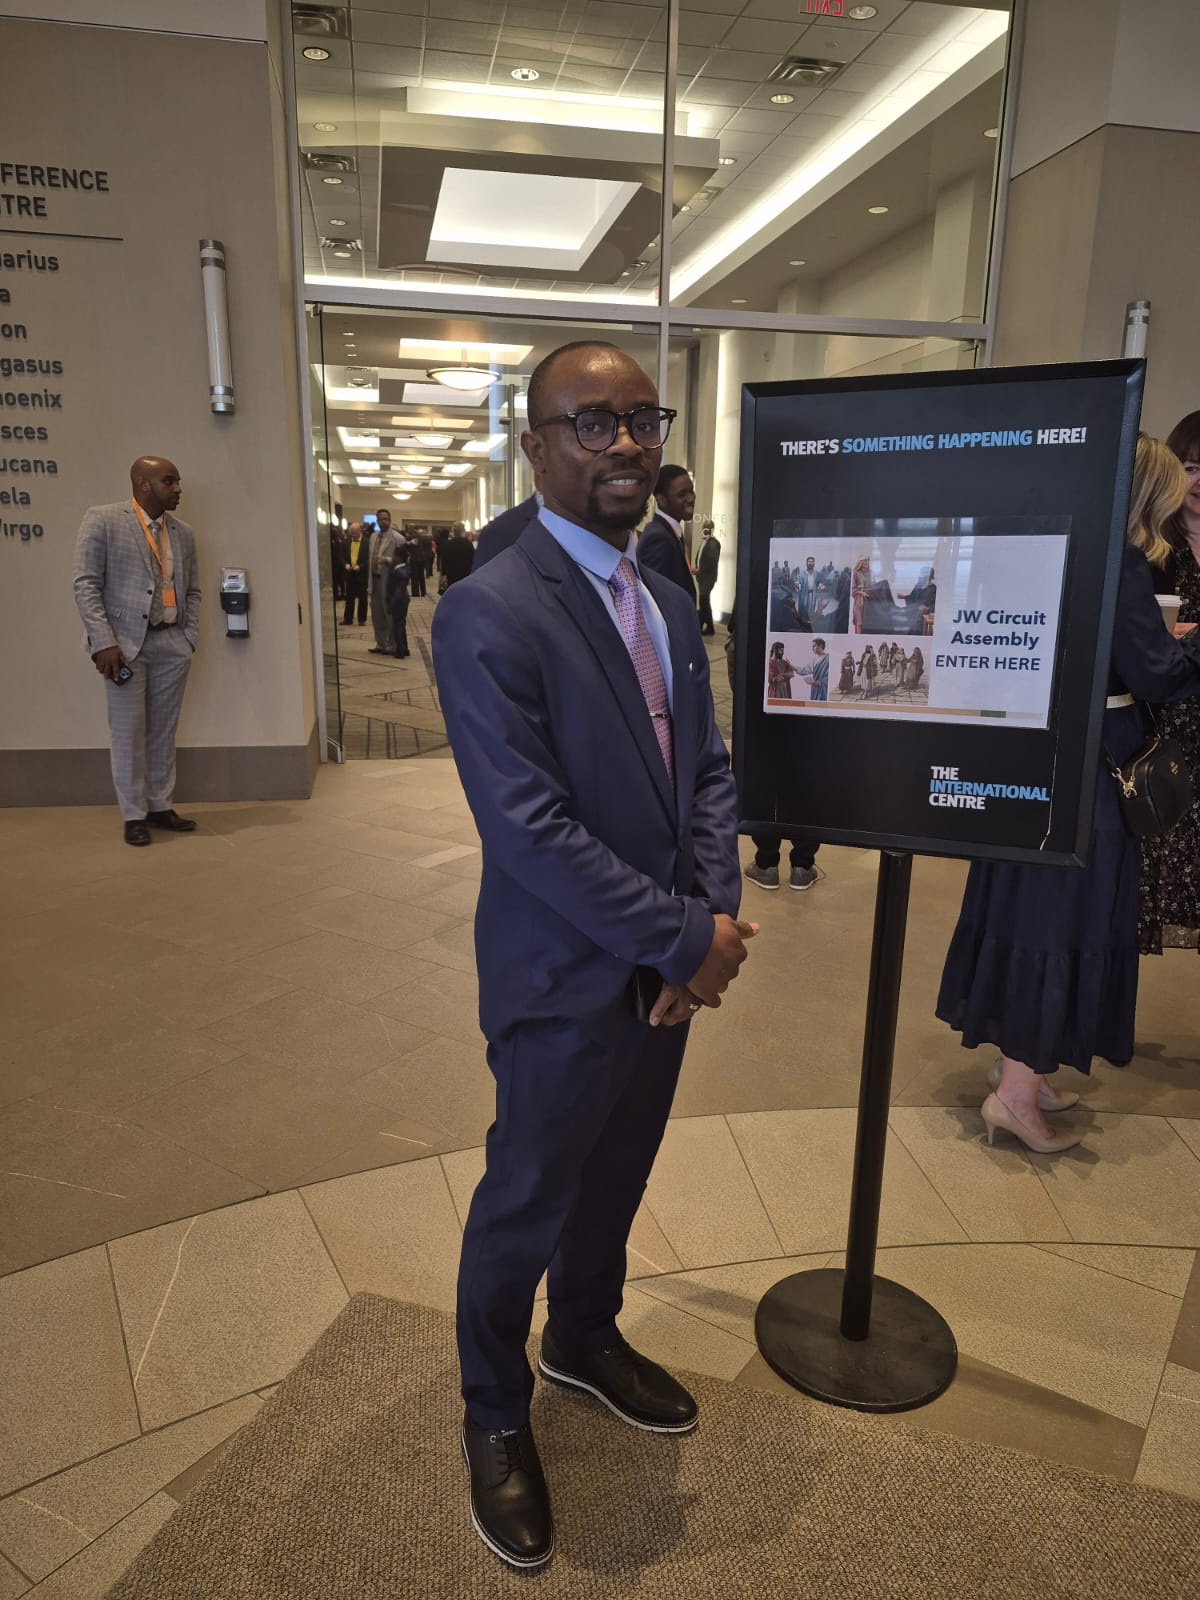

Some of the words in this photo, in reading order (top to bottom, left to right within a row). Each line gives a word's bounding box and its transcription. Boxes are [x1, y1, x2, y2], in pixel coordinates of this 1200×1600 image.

[0, 163, 109, 192] FERENCE
[0, 194, 47, 217] TRE
[0, 250, 59, 271] arius
[781, 439, 839, 456] THERE'S
[842, 434, 934, 453] SOMETHING
[938, 430, 1033, 449] HAPPENING
[1037, 427, 1087, 445] HERE!
[953, 609, 982, 624] JW
[986, 610, 1047, 626] Circuit
[950, 631, 1040, 650] Assembly
[935, 654, 990, 669] ENTER
[994, 656, 1041, 671] HERE
[930, 765, 960, 780] THE
[929, 779, 1050, 801] INTERNATIONAL
[928, 793, 986, 810] CENTRE
